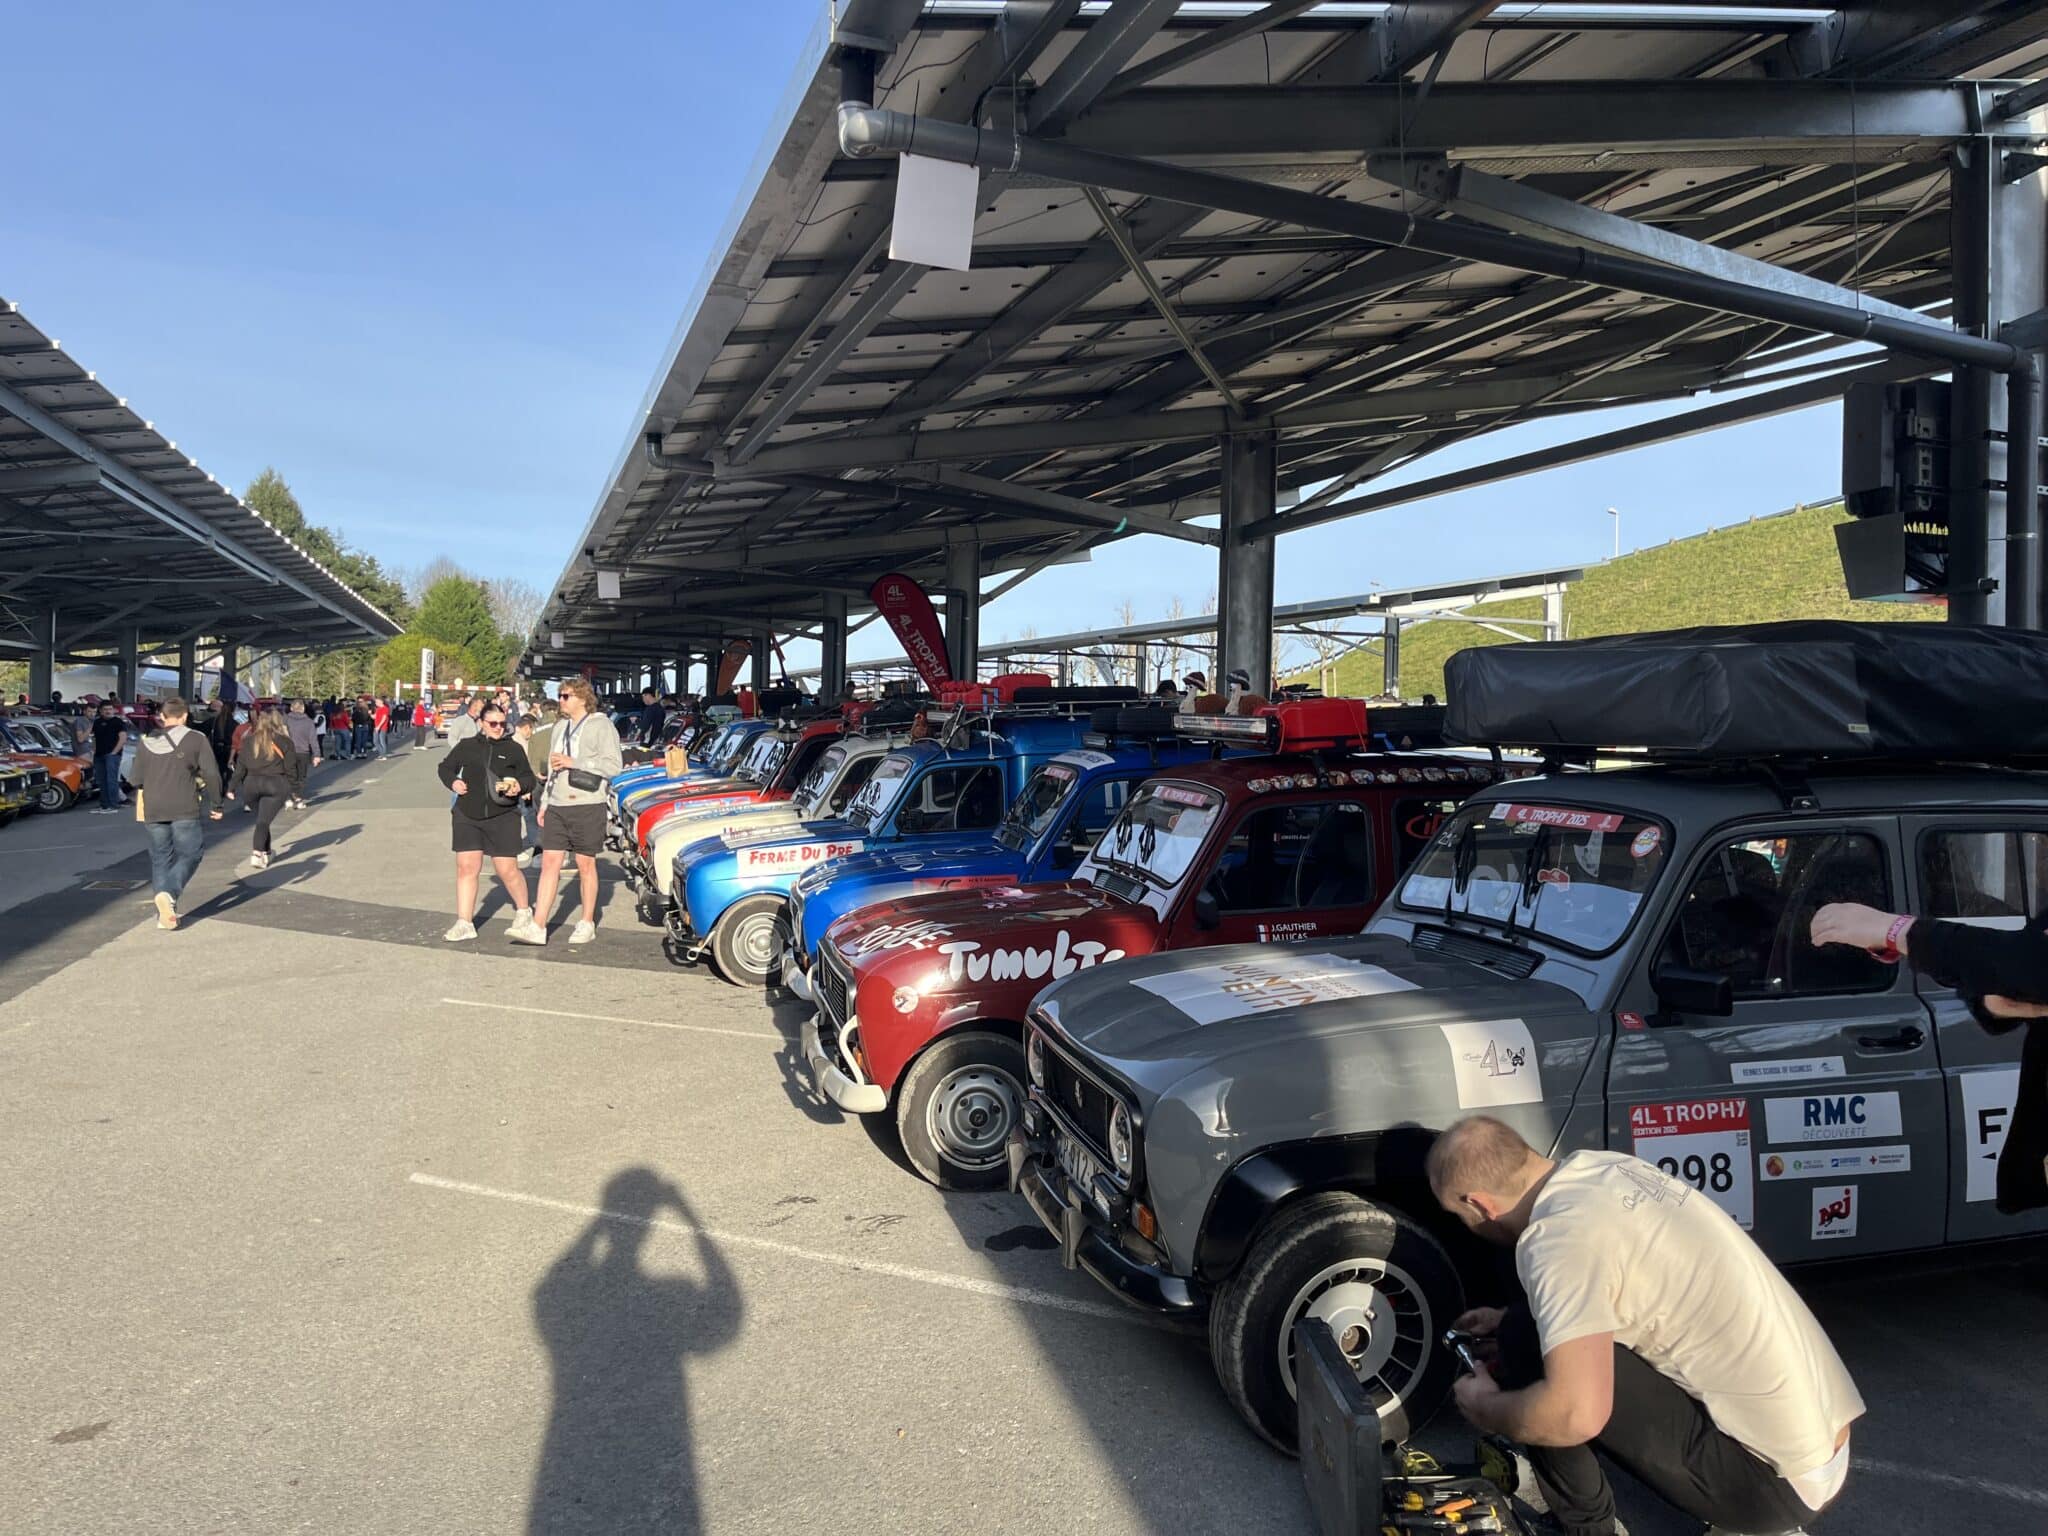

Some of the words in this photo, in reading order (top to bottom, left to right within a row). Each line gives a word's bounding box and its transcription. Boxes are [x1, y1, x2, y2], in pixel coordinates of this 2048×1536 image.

[887, 585, 904, 596] 4L
[910, 628, 947, 677] TROPHY
[1632, 1106, 1657, 1125] 4L
[1663, 1100, 1746, 1122] TROPHY
[1804, 1095, 1866, 1127] RMC
[1802, 1127, 1868, 1140] DÉCOUVERTE
